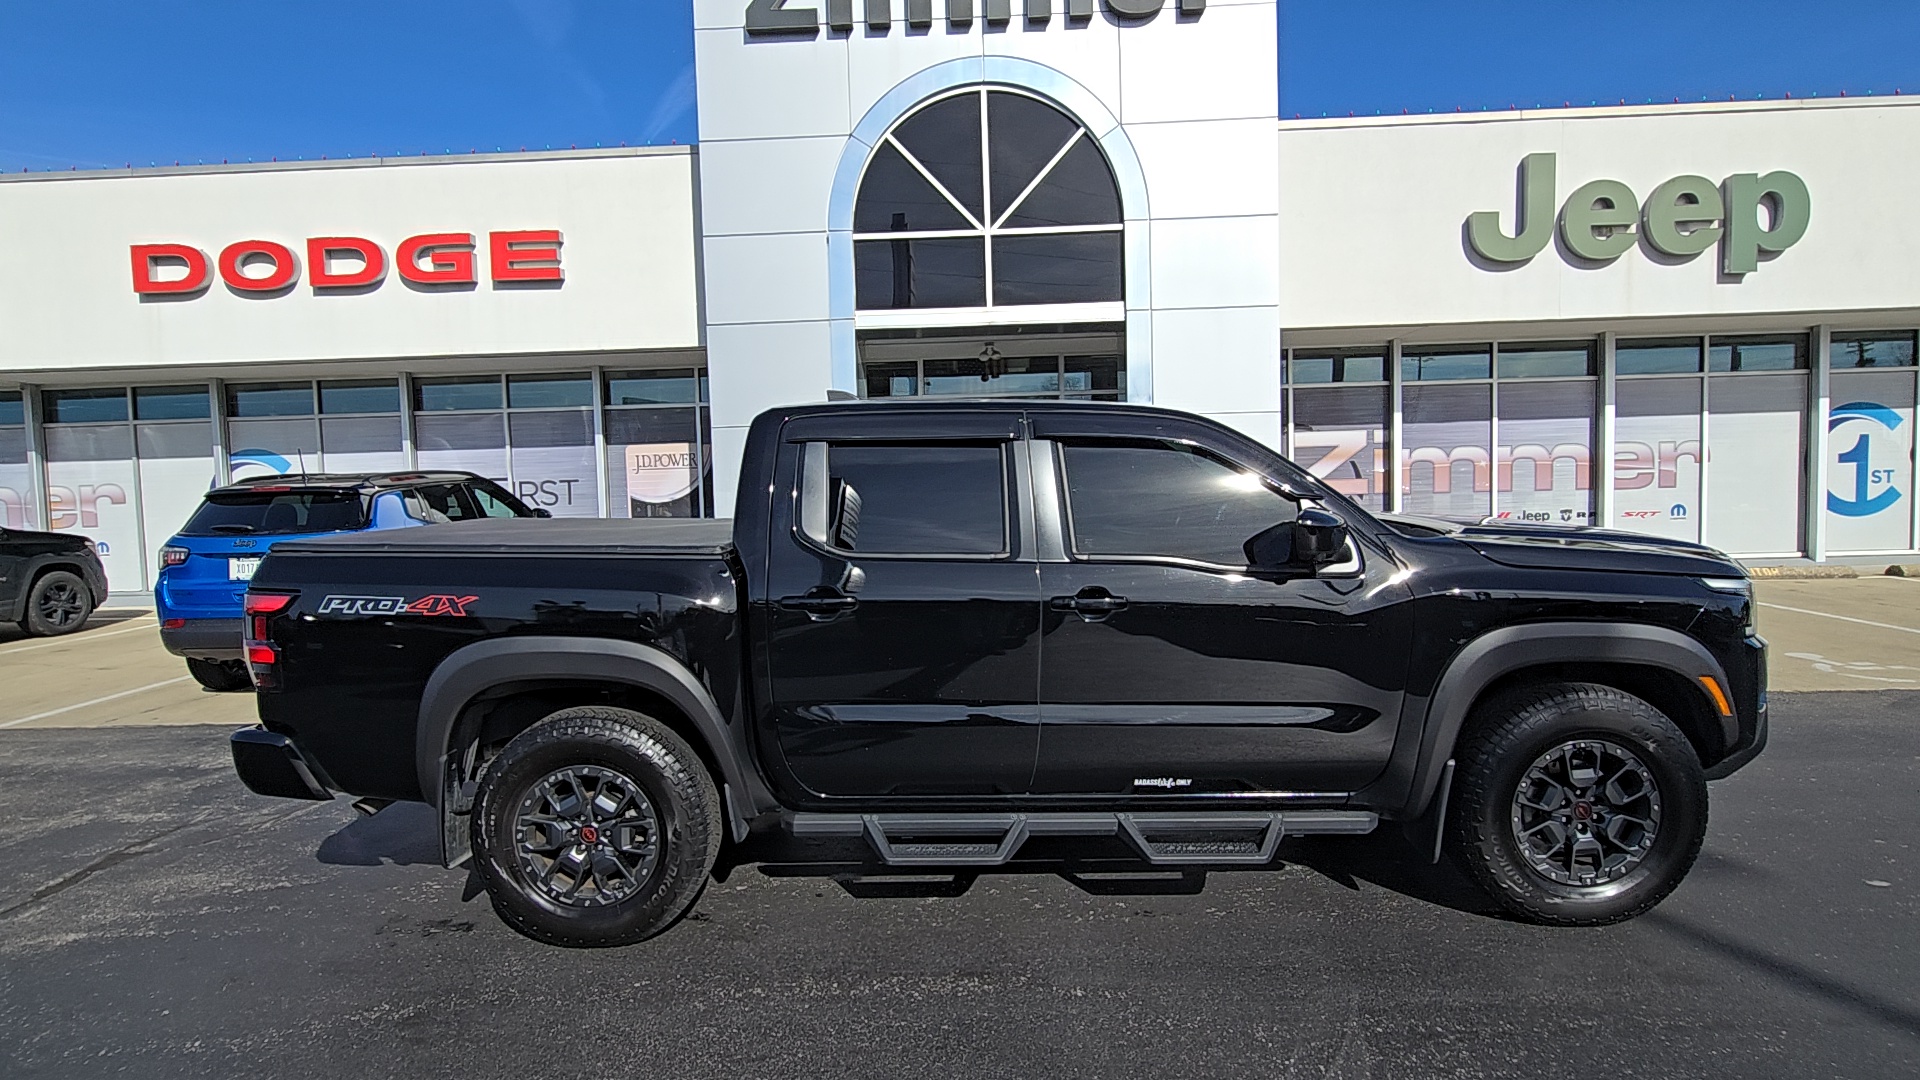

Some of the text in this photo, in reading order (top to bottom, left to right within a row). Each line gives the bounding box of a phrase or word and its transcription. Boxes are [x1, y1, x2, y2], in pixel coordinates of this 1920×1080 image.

[1463, 152, 1810, 280] Jeep
[130, 230, 564, 300] DODGE
[1517, 505, 1551, 521] Jeep
[318, 594, 479, 617] PRO-4X
